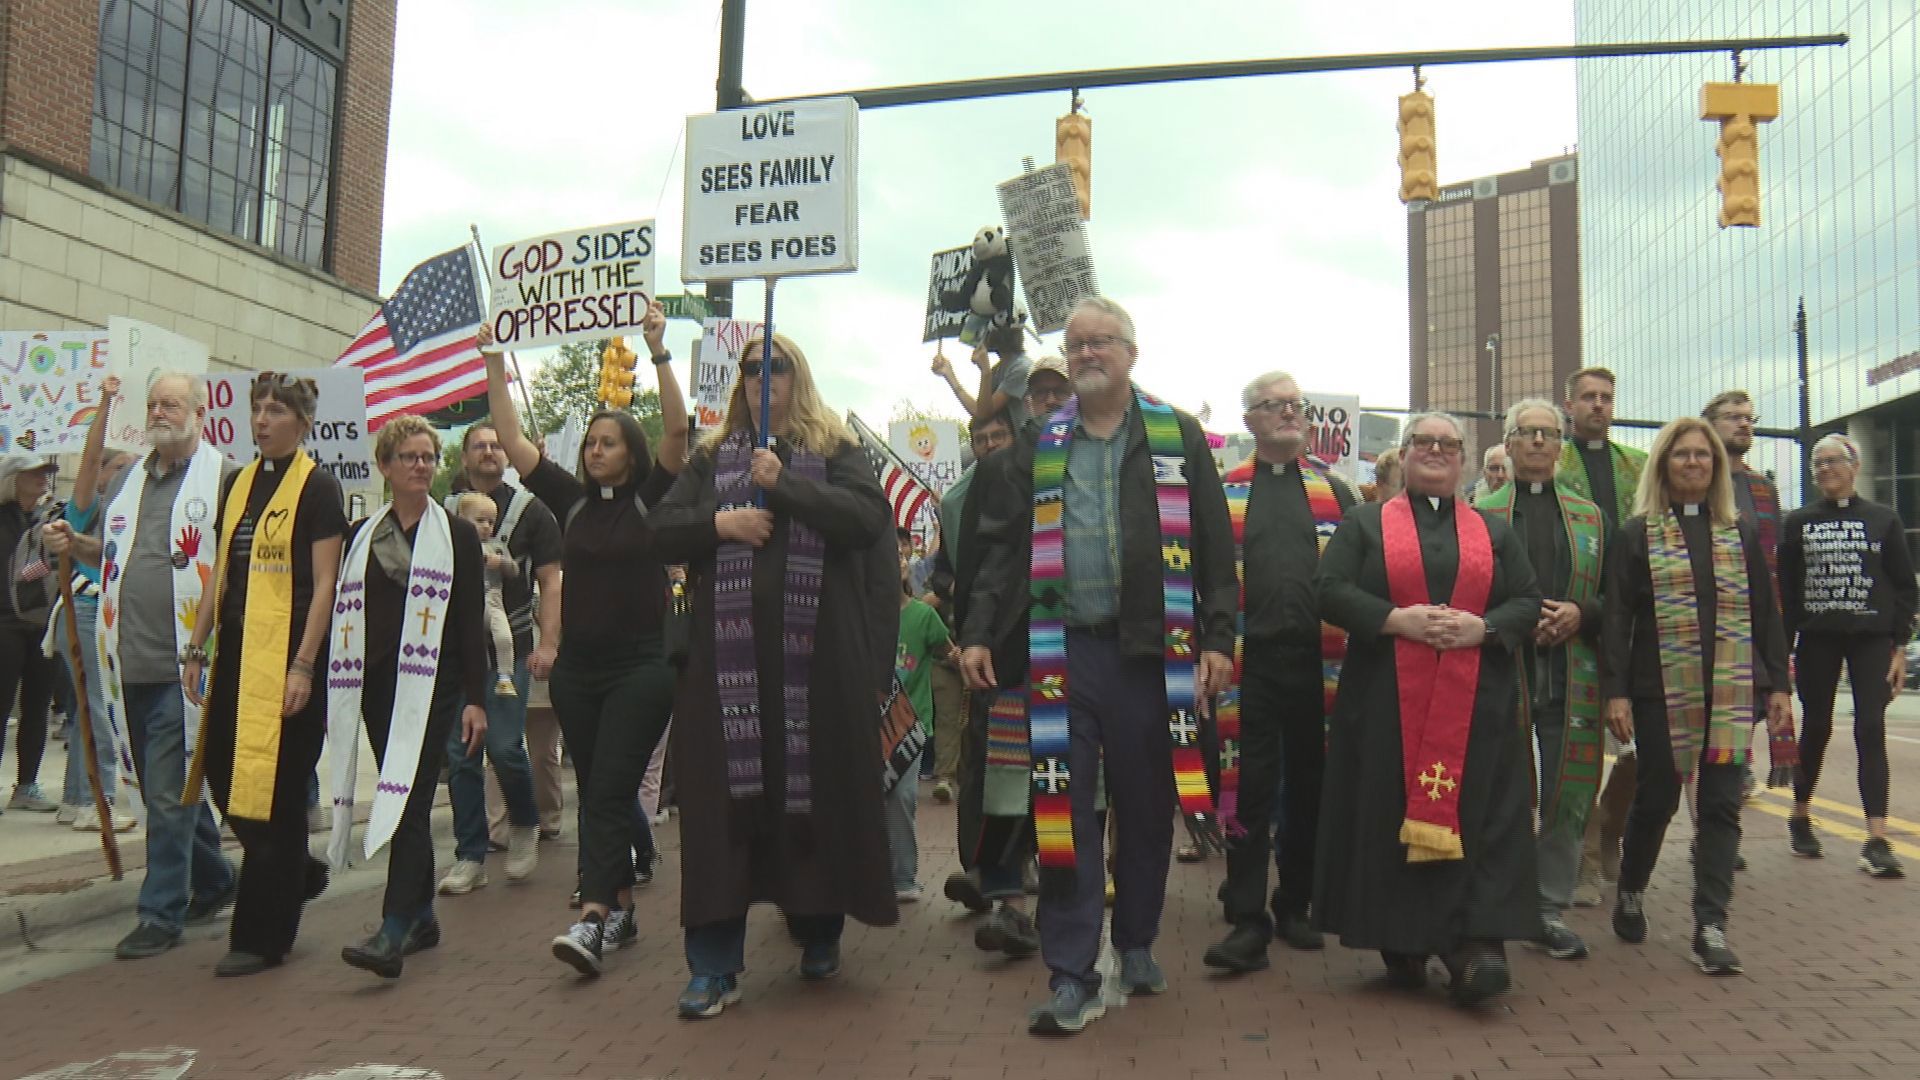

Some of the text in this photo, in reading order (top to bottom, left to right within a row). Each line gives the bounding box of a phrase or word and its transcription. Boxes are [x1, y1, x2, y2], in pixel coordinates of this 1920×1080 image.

[742, 110, 795, 142] LOVE
[701, 154, 835, 194] SEES FAMILY
[735, 200, 800, 226] FEAR
[500, 225, 652, 281] GOD SIDES
[699, 234, 837, 266] SEES FOES
[518, 268, 584, 306] WITH
[591, 260, 643, 290] THE
[1027, 284, 1056, 310] YOU
[1054, 277, 1079, 303] DID
[1079, 272, 1096, 299] IT
[494, 291, 650, 343] OPPRESSED
[0, 339, 109, 376] VOTE
[1309, 404, 1348, 425] NO
[202, 415, 235, 446] NO
[1306, 424, 1352, 457] INGS
[904, 461, 956, 481] PEACH
[1802, 530, 1866, 542] neutral in
[1813, 522, 1839, 535] you
[1841, 520, 1865, 531] are
[257, 550, 286, 560] LOVE
[1802, 540, 1882, 555] situations of
[1804, 575, 1874, 589] chosen the
[1828, 563, 1862, 576] have
[1804, 587, 1869, 600] side of the
